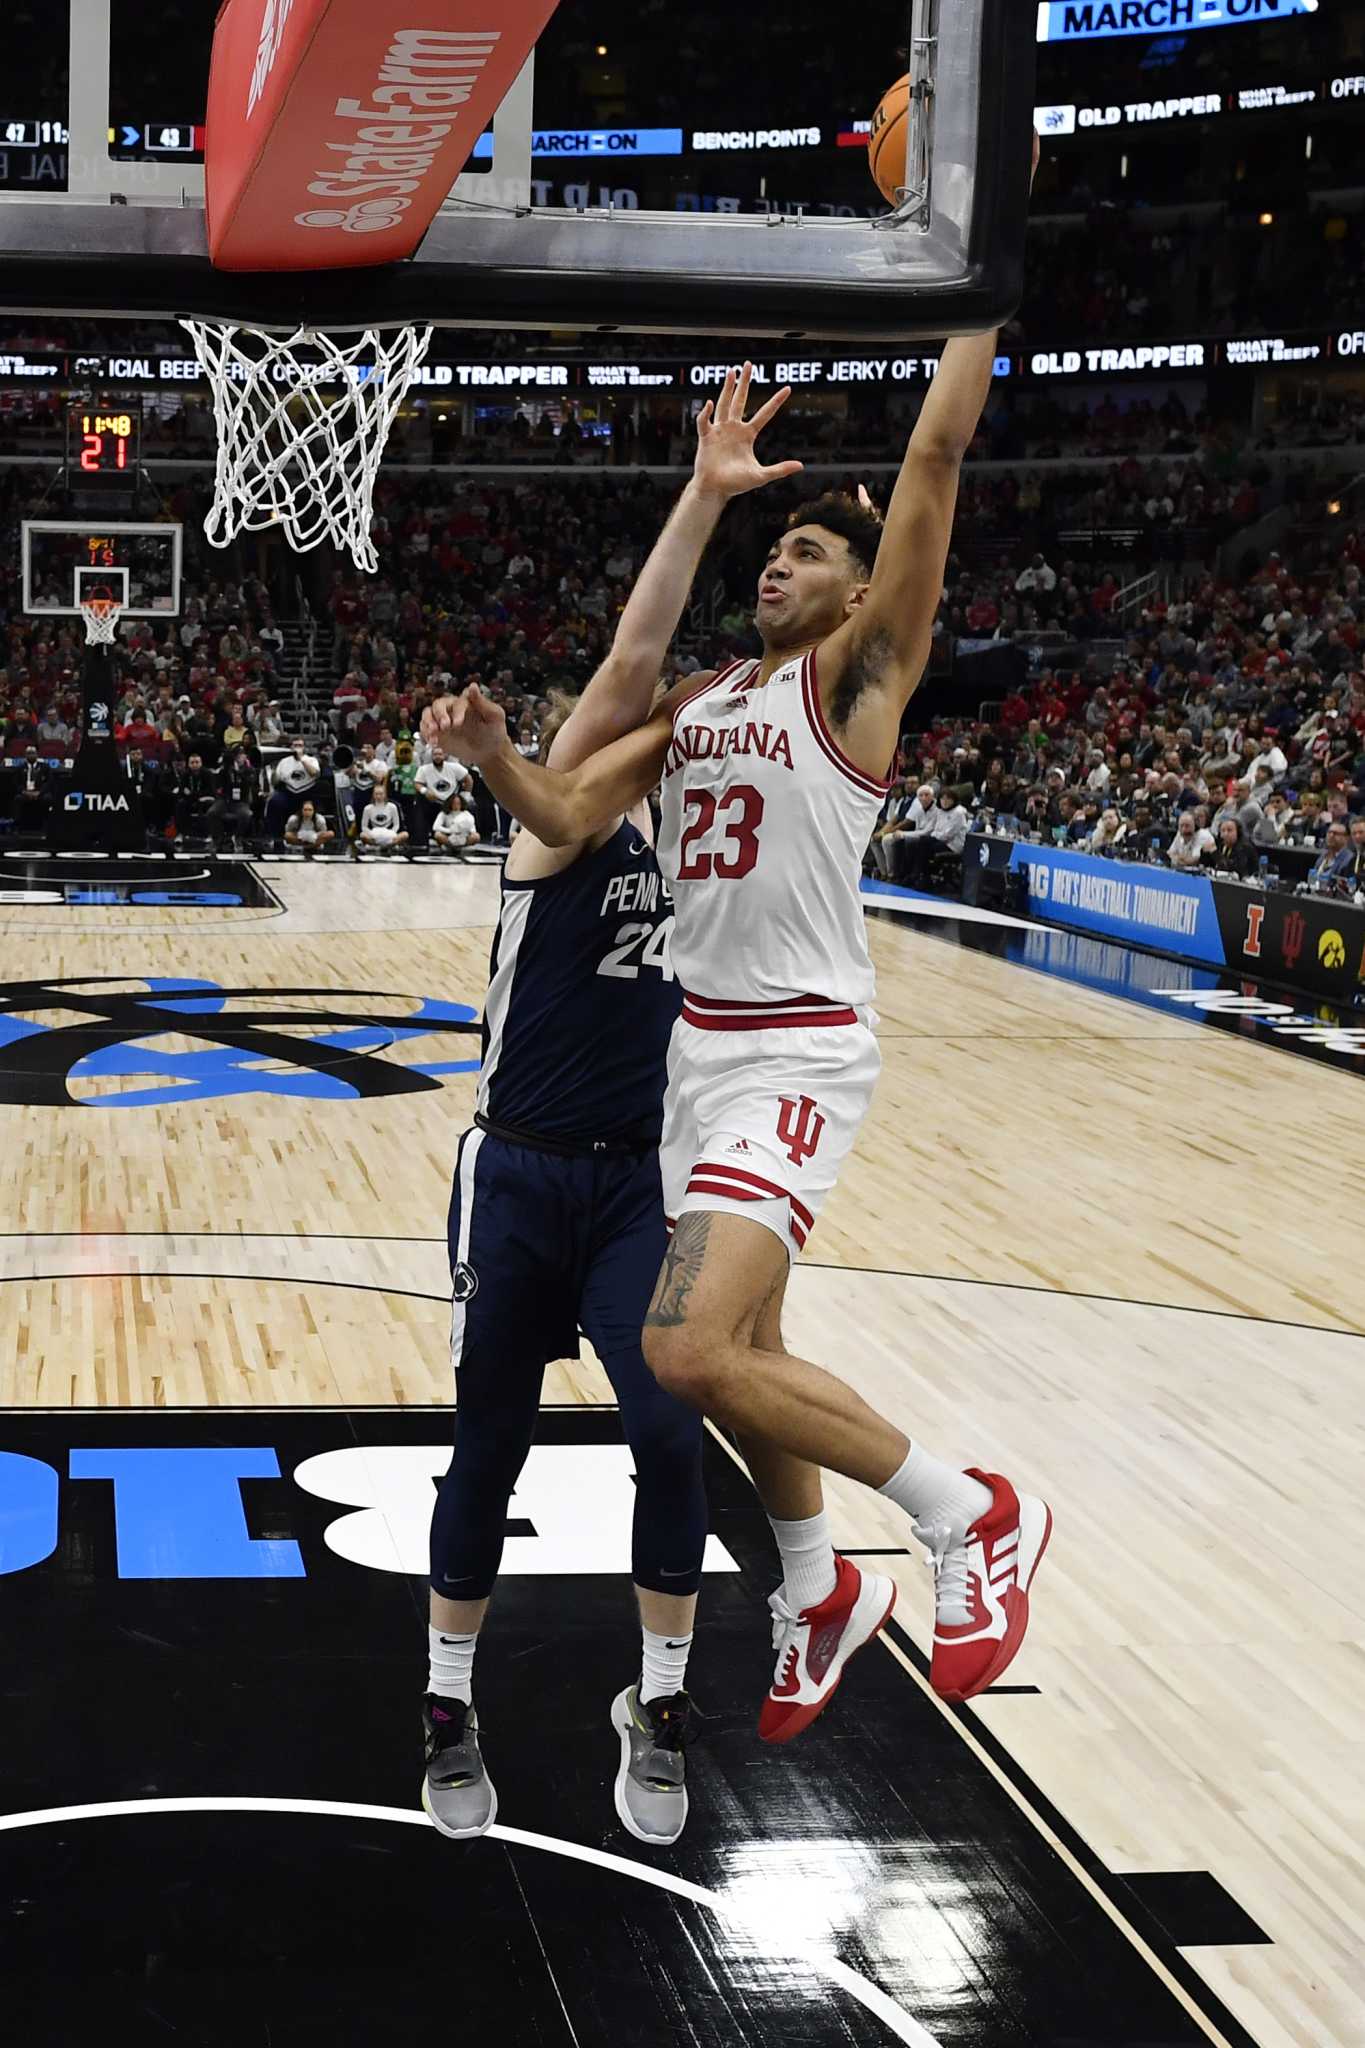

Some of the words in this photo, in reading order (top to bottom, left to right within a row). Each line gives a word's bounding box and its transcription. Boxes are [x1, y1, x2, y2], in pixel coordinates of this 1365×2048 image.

[1063, 0, 1194, 33] MARCH
[1078, 108, 1121, 127] OLD
[1125, 94, 1222, 122] TRAPPER
[6, 123, 26, 143] 47
[532, 134, 589, 151] ARCH
[608, 134, 637, 150] ON
[692, 131, 754, 150] BENCH
[756, 127, 821, 148] POINTS
[1337, 331, 1365, 355] OF
[690, 364, 770, 384] OFFCAL
[775, 363, 823, 383] BEEF
[826, 359, 887, 381] JERKY
[892, 358, 918, 380] OF
[1031, 352, 1080, 375] OLD
[1085, 344, 1204, 371] TRAPPER
[456, 366, 567, 385] TRAPPER
[83, 415, 131, 437] 11:48
[81, 435, 125, 469] 21
[664, 721, 795, 778] INDIANA
[84, 794, 129, 811] TIAA
[677, 784, 764, 880] 23
[600, 872, 660, 917] PENN
[1051, 868, 1079, 906] MEN'S
[1080, 874, 1130, 919] BASKETBALL
[1132, 885, 1200, 936] TOURNAMENT
[597, 915, 676, 982] 24
